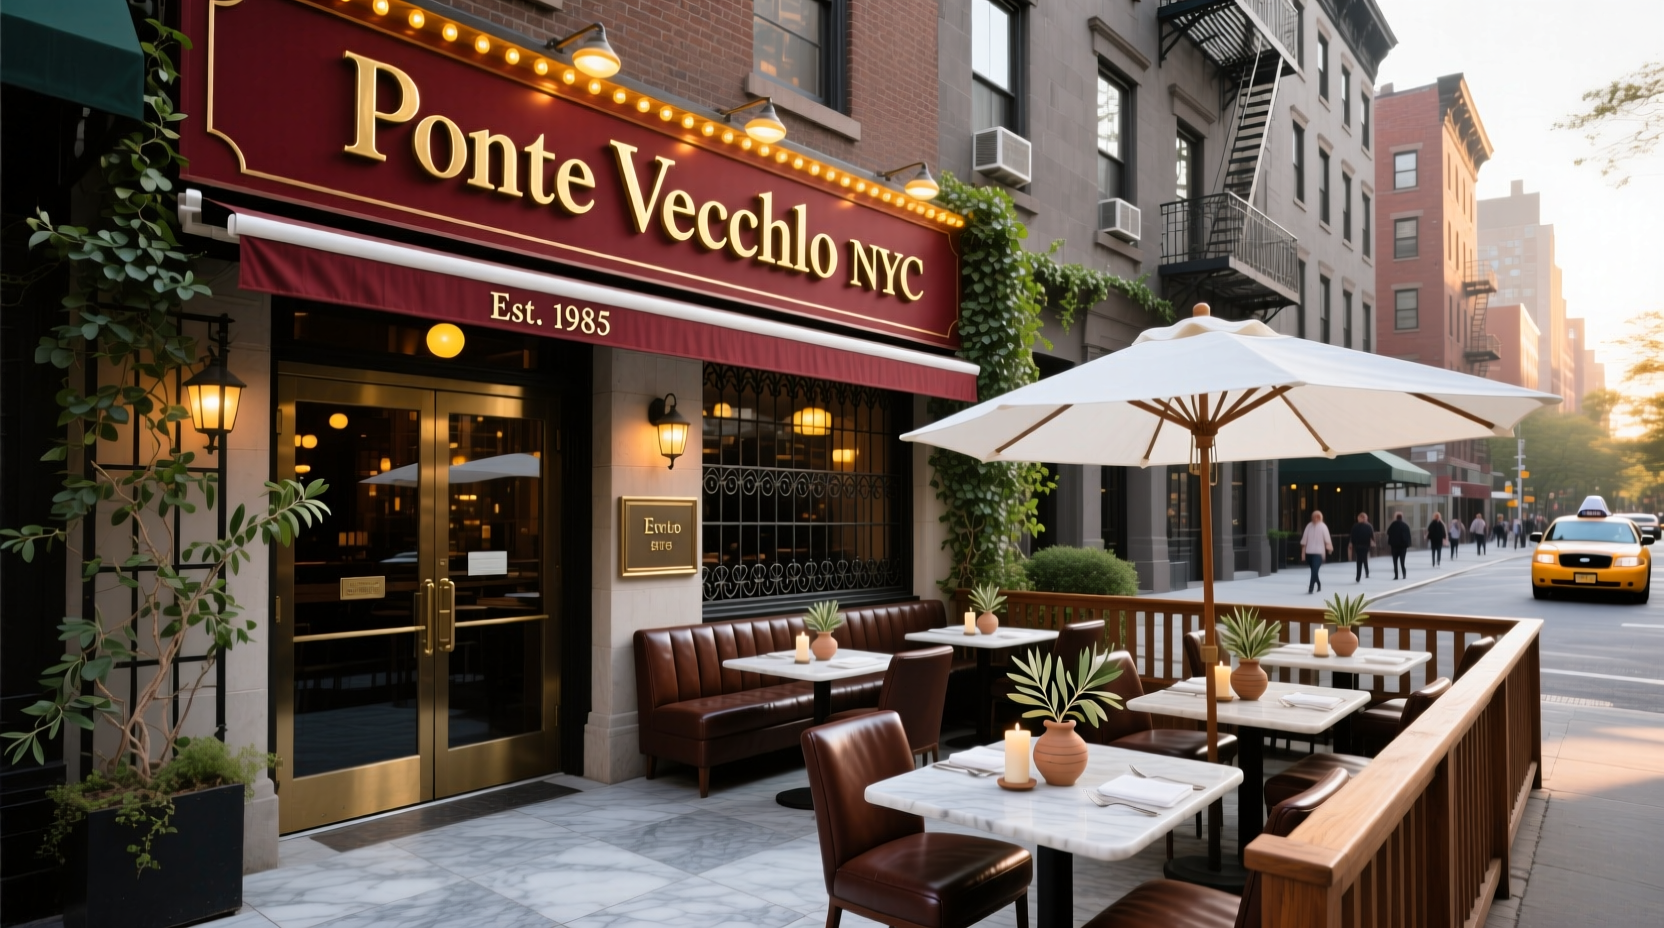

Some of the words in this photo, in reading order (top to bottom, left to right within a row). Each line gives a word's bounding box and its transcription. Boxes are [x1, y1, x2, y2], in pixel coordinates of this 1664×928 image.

[344, 50, 596, 215] Ponte
[609, 139, 839, 279] Vecchlo
[849, 238, 924, 302] NYC
[490, 291, 543, 326] Est.
[553, 303, 611, 336] 1985
